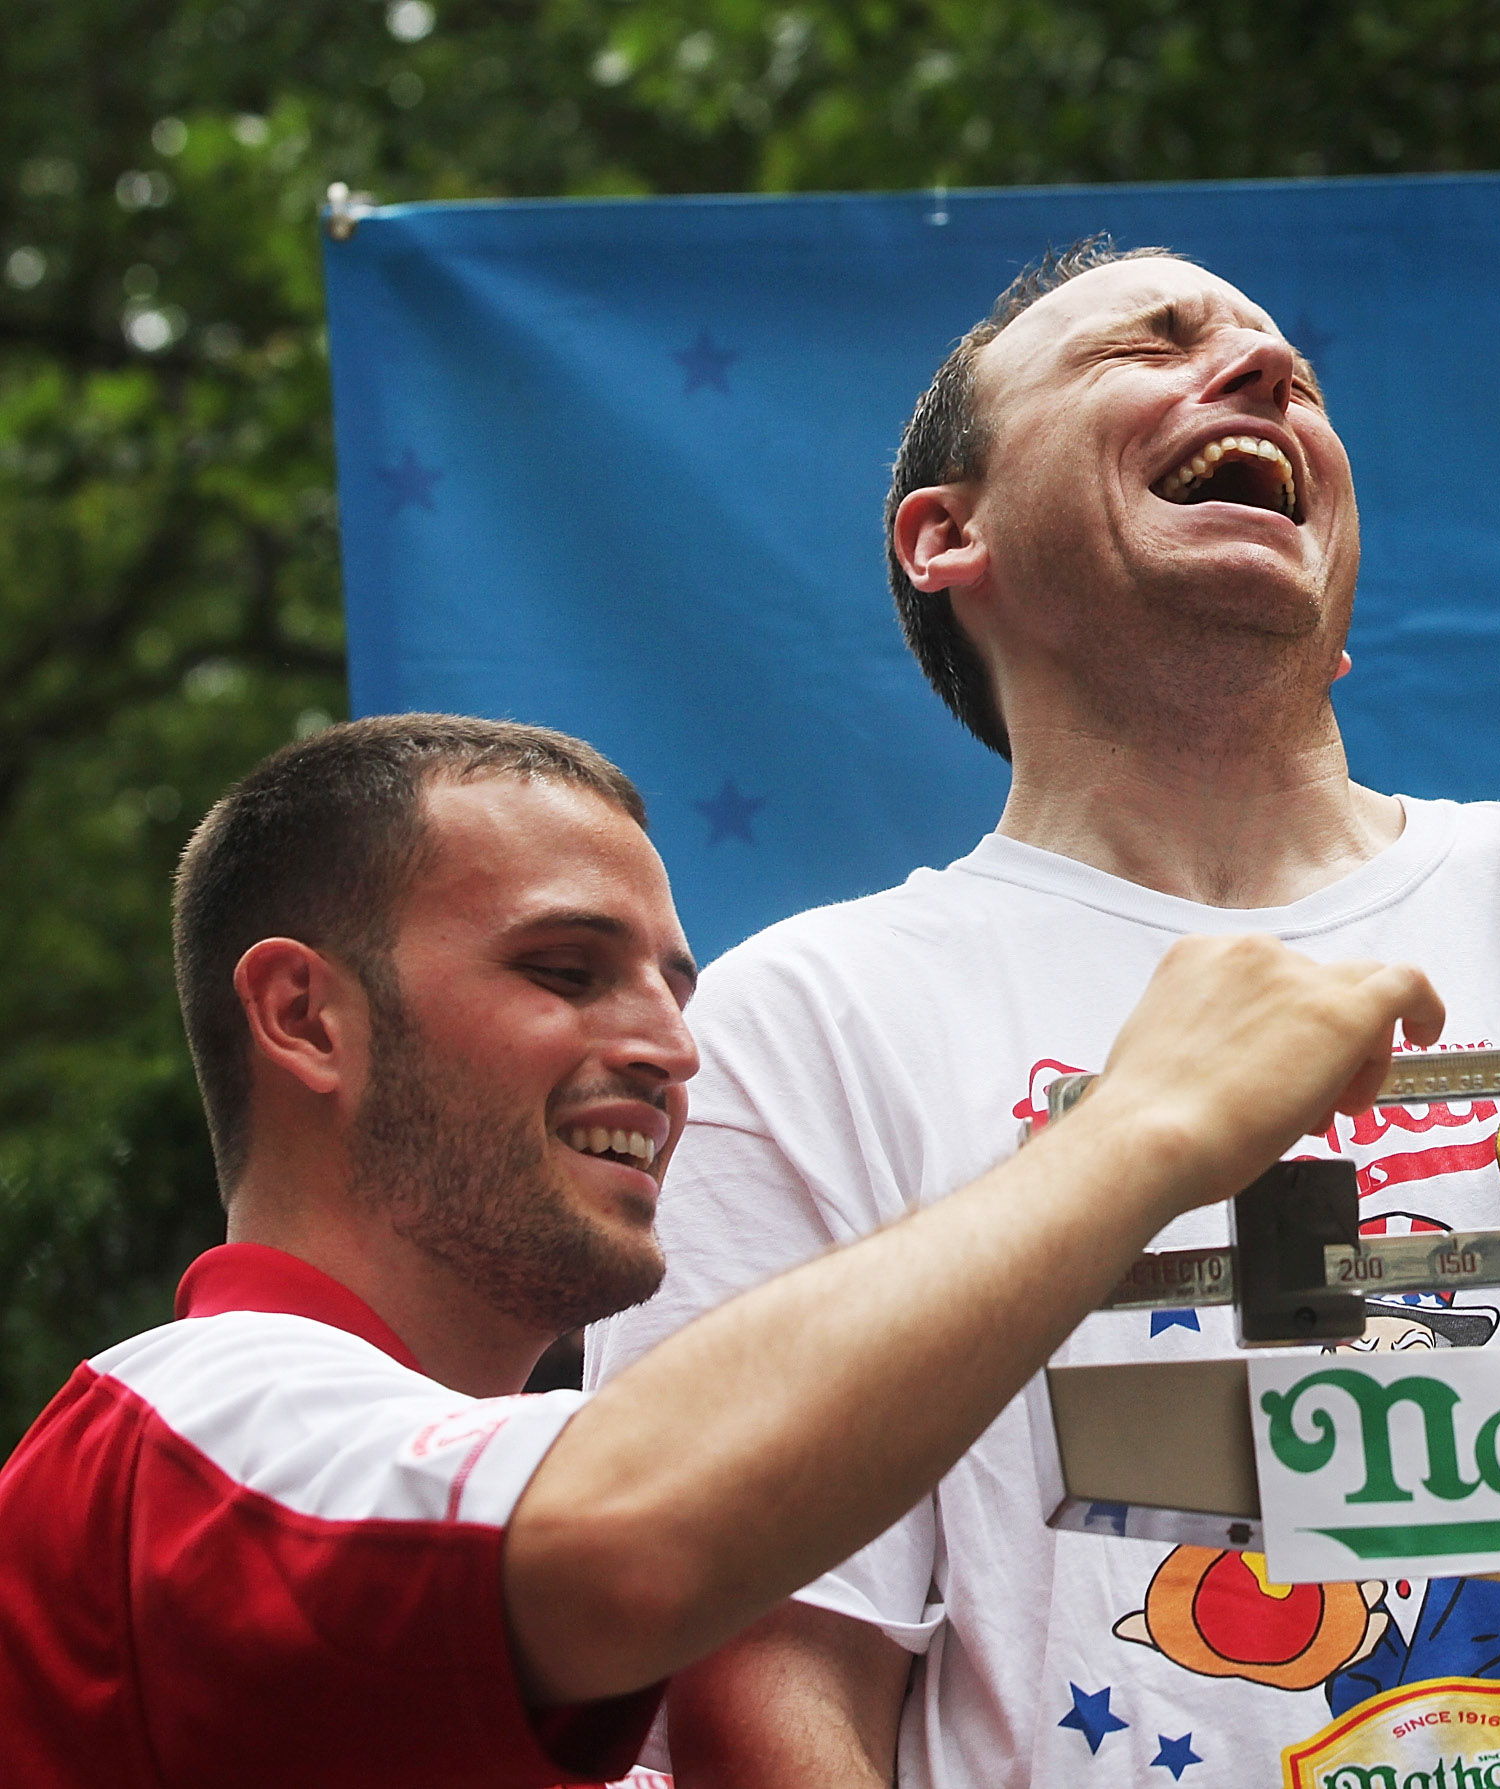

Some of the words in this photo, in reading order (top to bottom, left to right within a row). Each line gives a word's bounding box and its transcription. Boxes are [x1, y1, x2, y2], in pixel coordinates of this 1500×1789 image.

[1125, 1256, 1223, 1286] ETECTO
[1340, 1257, 1384, 1281] 200
[1439, 1251, 1476, 1274] 150
[1392, 1711, 1451, 1739] SINCE
